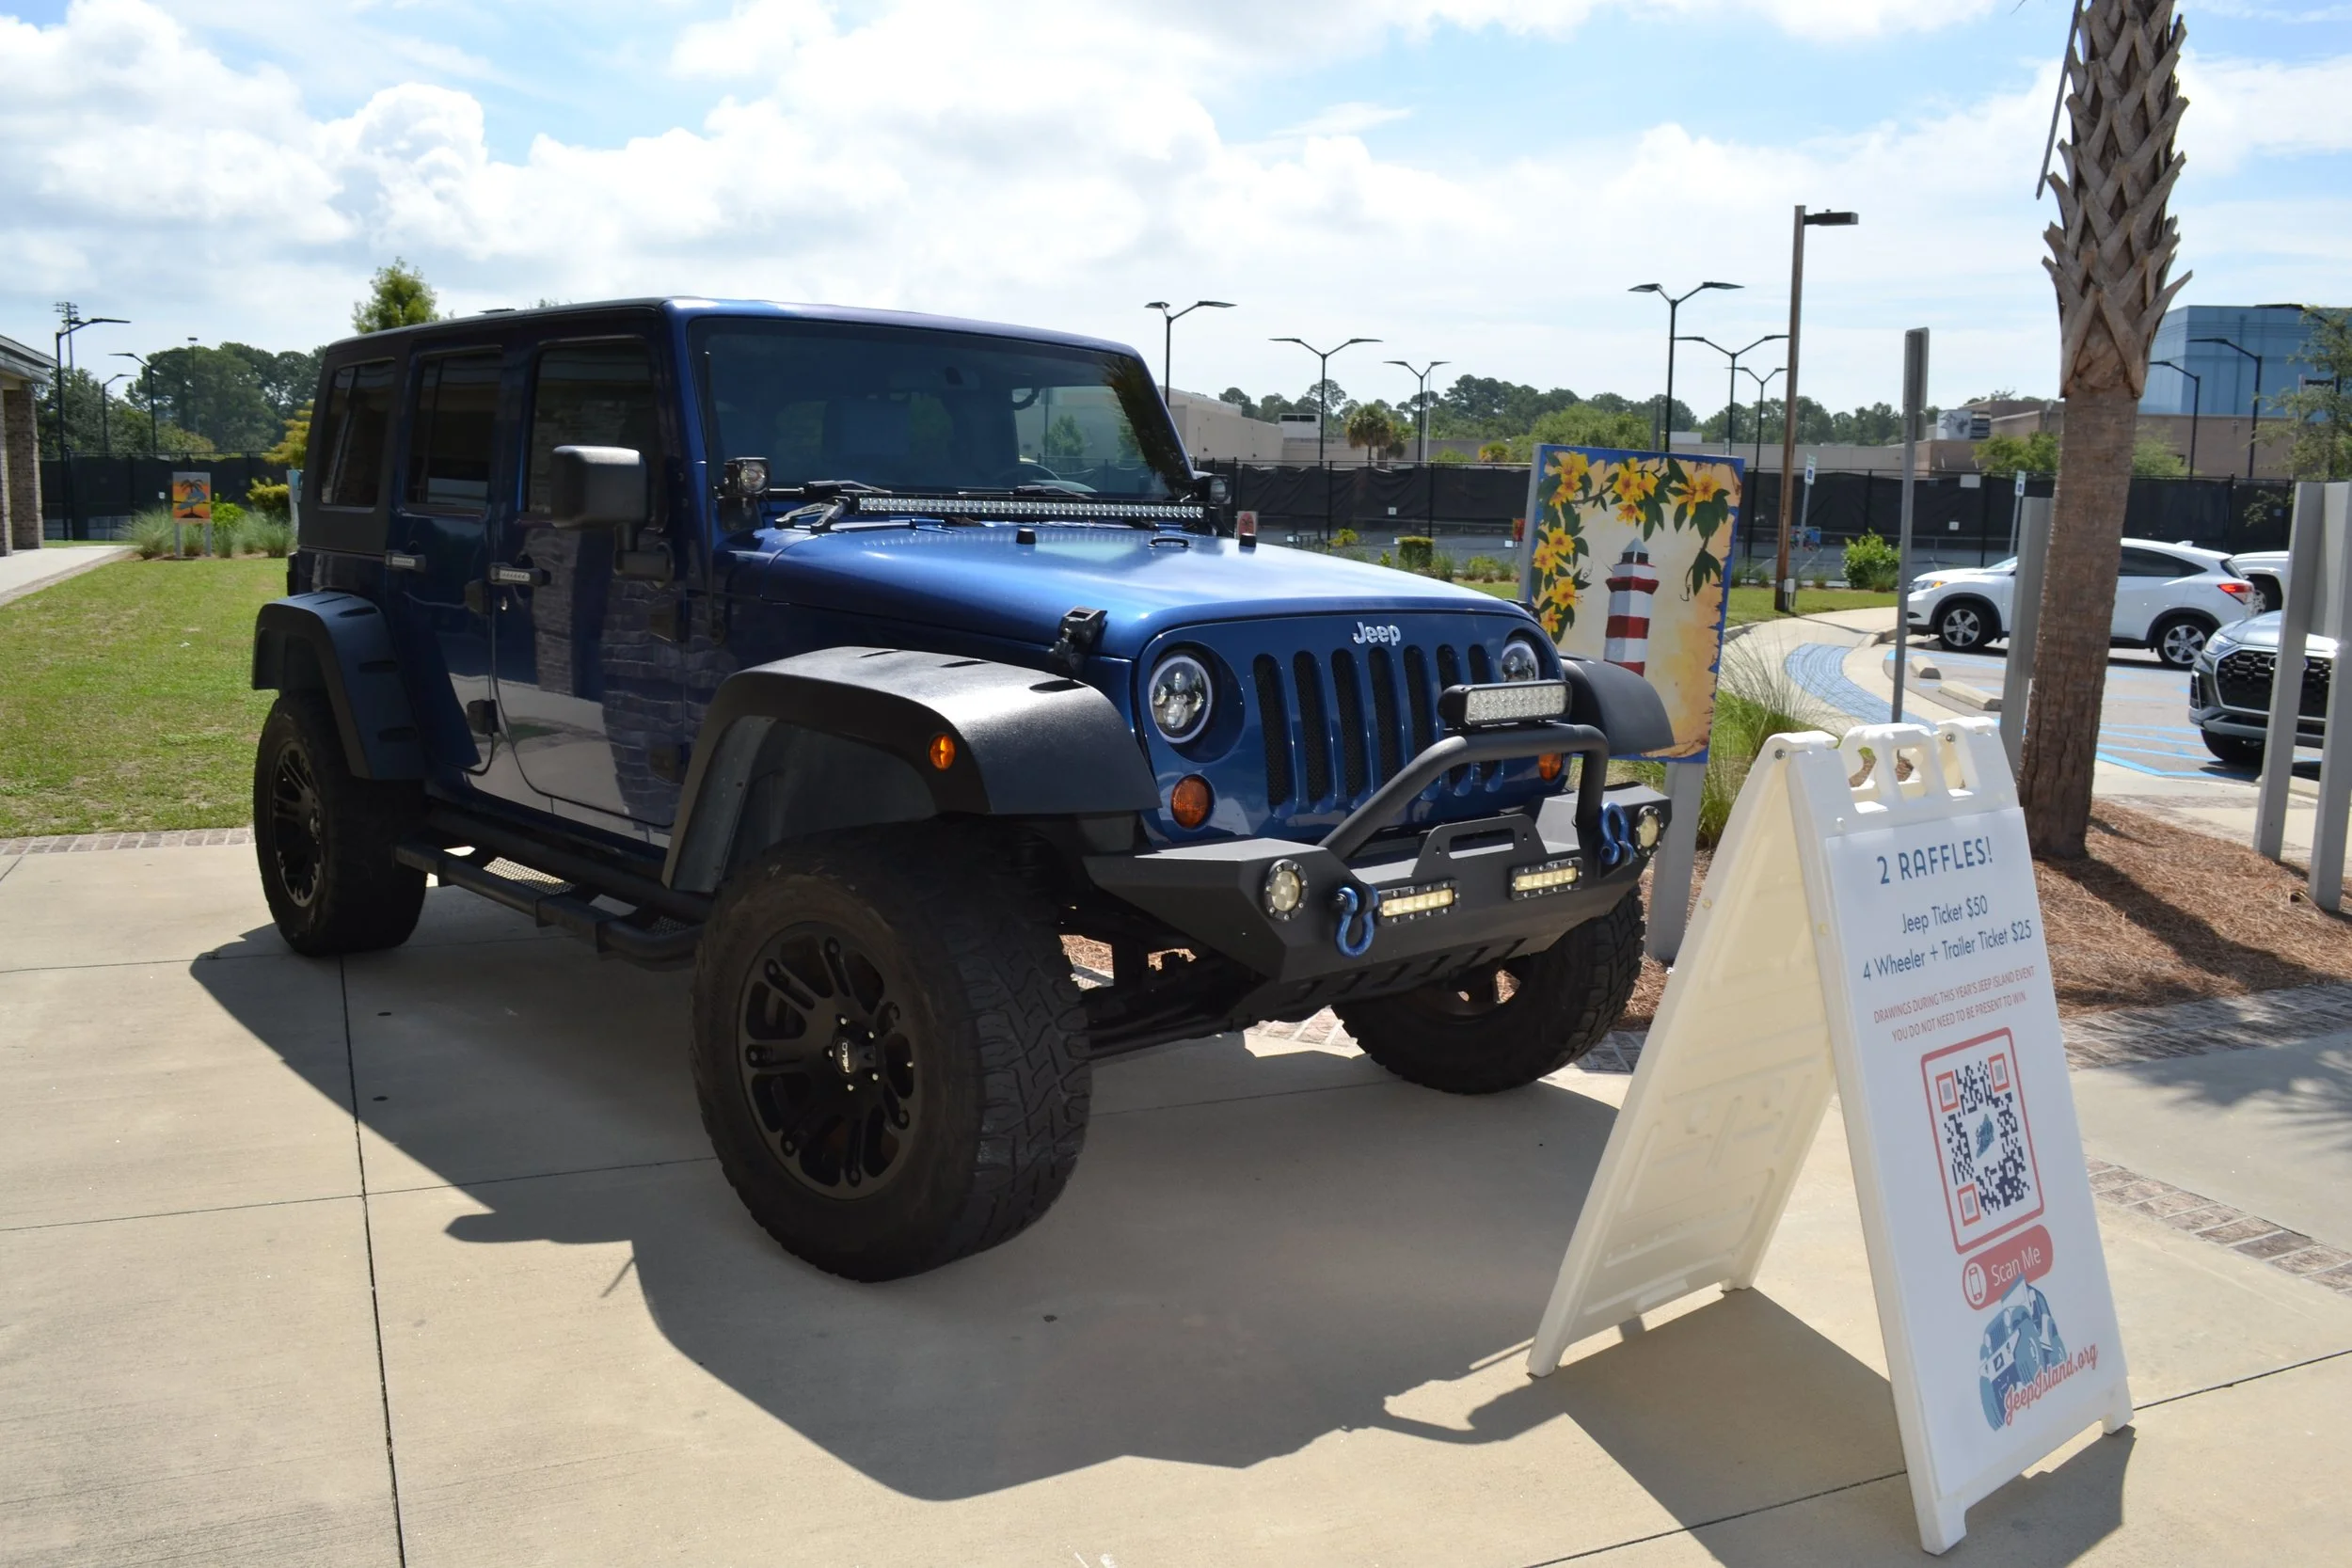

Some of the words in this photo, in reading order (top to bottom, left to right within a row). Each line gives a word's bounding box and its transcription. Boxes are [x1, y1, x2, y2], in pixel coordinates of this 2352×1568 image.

[1352, 622, 1401, 646] Jeep
[1876, 855, 1890, 885] 2
[1898, 835, 1993, 880] RAFFLES!
[1901, 912, 1930, 934] Jeep
[1931, 902, 1963, 927] Ticket
[1965, 895, 1988, 918] $50
[1863, 960, 1871, 981] 4
[1874, 948, 1926, 977] Wheeler
[1931, 944, 1939, 961] +
[1941, 935, 1977, 959] Trailer
[1978, 927, 2009, 951] Ticket
[2010, 919, 2032, 943] $25
[1873, 1001, 1913, 1024] DRAWINGS
[1913, 993, 1939, 1012] DURING
[1939, 989, 1955, 1004] THIS
[1955, 982, 1978, 998] YEAR'S
[1978, 977, 1992, 993] JEEP
[1993, 971, 2014, 988] ISLAND
[2015, 965, 2034, 981] EVENT
[1892, 1026, 1908, 1043] YOU
[1909, 1022, 1920, 1037] DO
[1921, 1018, 1936, 1033] NOT
[1936, 1012, 1955, 1028] NEED
[1956, 1008, 1965, 1022] TO
[1965, 1006, 1976, 1020] BE
[1976, 997, 2002, 1016] PRESENT
[2003, 995, 2012, 1007] TO
[2012, 990, 2026, 1005] WIN
[1991, 1259, 2022, 1287] Scan
[2021, 1245, 2042, 1271] Me
[2005, 1343, 2098, 1427] JeepIsland.org
